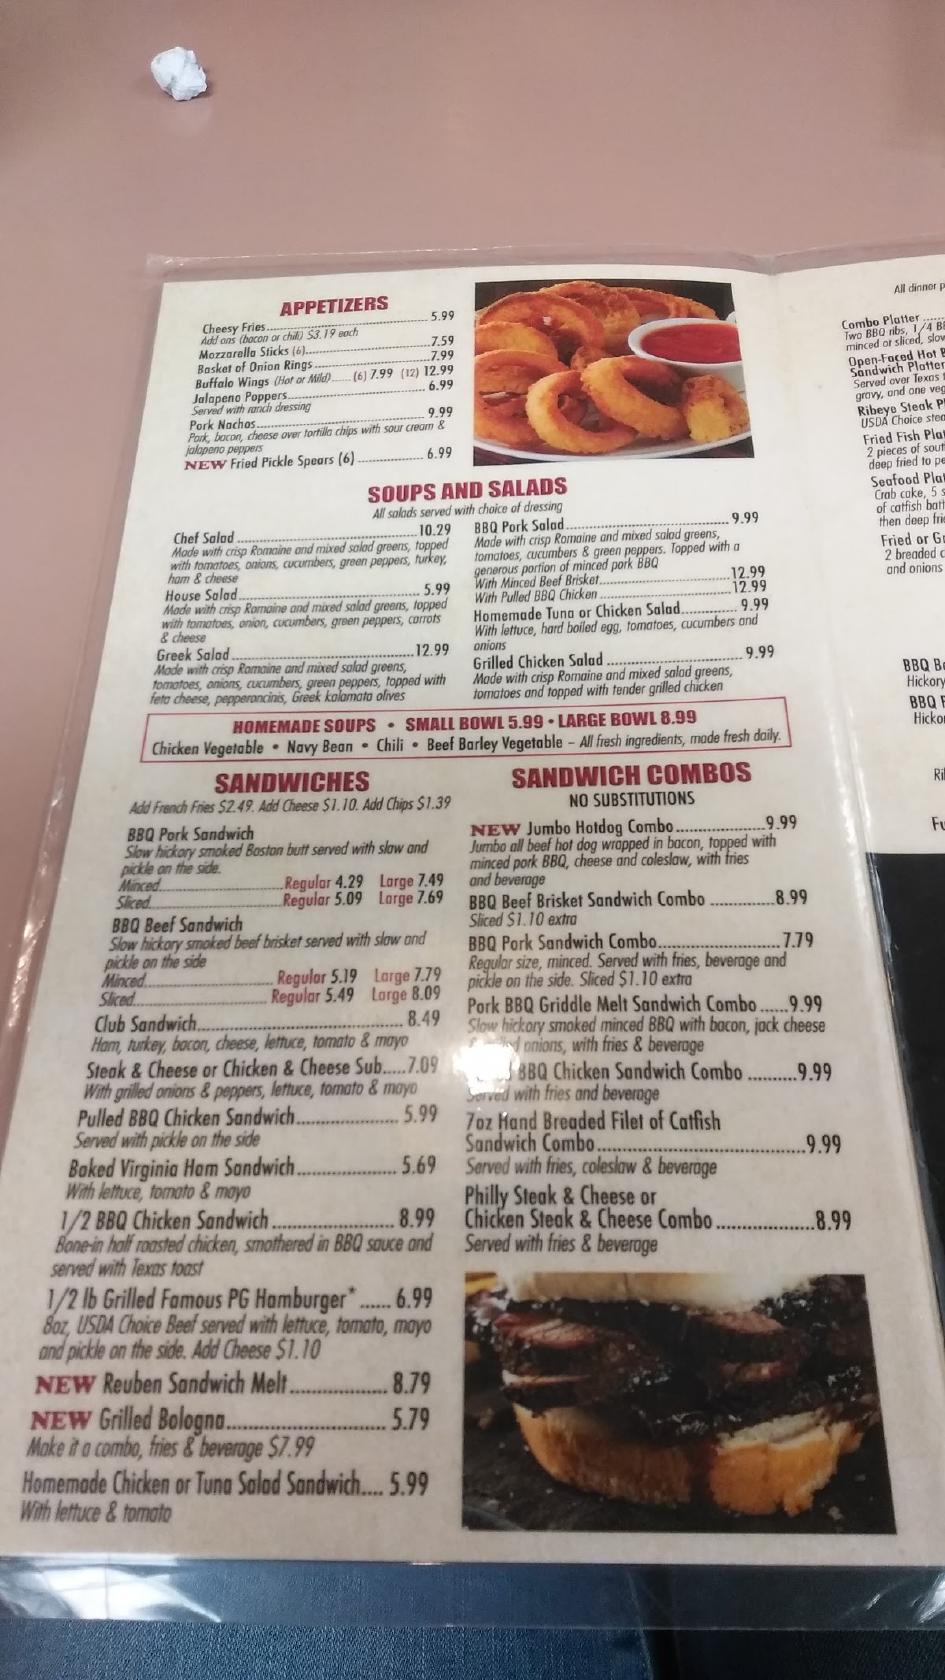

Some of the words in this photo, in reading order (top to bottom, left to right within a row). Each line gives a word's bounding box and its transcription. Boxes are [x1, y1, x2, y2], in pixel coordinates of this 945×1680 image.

[894, 284, 905, 294] All
[909, 283, 936, 292] dinner
[280, 296, 388, 316] APPETIZERS
[202, 323, 239, 334] Cheesy
[241, 322, 266, 332] Fries
[431, 311, 454, 321] 5.99
[842, 318, 879, 329] Combo
[883, 314, 919, 325] Platter
[201, 336, 218, 345] Add
[221, 336, 236, 344] ons
[240, 333, 268, 345] (bacon
[271, 332, 281, 341] or
[283, 330, 303, 341] chili)
[307, 329, 336, 339] $3.19
[339, 328, 359, 337] each
[199, 348, 256, 360] Mozzarella
[260, 347, 289, 357] Sticks
[292, 346, 305, 356] (6)
[431, 336, 454, 346] 7.59
[198, 363, 231, 374] Basket
[235, 362, 245, 372] of
[250, 361, 280, 371] Onion
[284, 360, 312, 371] Rings
[431, 351, 454, 361] 7.99
[849, 350, 913, 367] Open-Faced
[917, 350, 936, 358] Hot
[850, 362, 903, 377] Sandwich
[193, 392, 241, 404] Jalapeno
[245, 390, 287, 402] Poppers
[429, 380, 453, 391] 6.99
[857, 405, 897, 417] Ribeye
[900, 400, 933, 413] Steak
[864, 432, 892, 445] Fried
[897, 429, 920, 442] Fish
[184, 460, 227, 470] NEW
[230, 457, 257, 468] Fried
[261, 455, 293, 467] Pickle
[298, 454, 334, 467] Spears
[338, 451, 355, 466] (6)
[427, 447, 451, 459] 6.99
[368, 483, 436, 503] SOUPS
[441, 482, 483, 500] AND
[489, 477, 567, 498] SALADS
[871, 474, 919, 487] Seafood
[875, 489, 896, 500] Crab
[900, 487, 926, 499] cake,
[475, 522, 497, 534] BBQ
[502, 520, 528, 532] Pork
[532, 518, 564, 531] Salad
[731, 512, 759, 525] 9.99
[174, 533, 199, 545] Chef
[203, 531, 234, 544] Salad
[419, 524, 451, 536] 10.29
[475, 536, 501, 548] Made
[504, 535, 525, 546] with
[529, 534, 550, 546] crisp
[555, 532, 596, 545] Romaine
[600, 531, 617, 542] and
[622, 529, 651, 541] mixed
[655, 529, 680, 540] salad
[684, 529, 720, 541] greens,
[881, 532, 911, 546] Fried
[917, 535, 928, 544] or
[887, 562, 906, 574] and
[909, 564, 943, 573] onions
[165, 591, 201, 601] House
[205, 589, 237, 600] Salad
[424, 584, 450, 596] 5.99
[157, 650, 192, 661] Greek
[196, 649, 229, 661] Salad
[416, 644, 449, 656] 12.99
[473, 655, 513, 670] Grilled
[518, 654, 564, 668] Chicken
[569, 652, 603, 667] Salad
[746, 646, 774, 659] 9.99
[903, 659, 929, 671] BBQ
[233, 720, 320, 734] HOMEMADE
[324, 719, 375, 732] SOUPS
[406, 718, 455, 731] SMALL
[460, 717, 505, 730] BOWL
[508, 715, 544, 729] 5.99
[558, 713, 606, 727] LARGE
[611, 712, 657, 726] BOWL
[660, 710, 697, 724] 8.99
[214, 771, 370, 794] SANDWICHES
[512, 765, 641, 788] SANDWICH
[647, 762, 752, 784] COMBOS
[570, 794, 588, 808] NO
[593, 792, 695, 806] SUBSTITUTIONS
[127, 829, 154, 842] BBQ
[159, 829, 188, 841] Pork
[194, 828, 254, 840] Sandwich
[471, 824, 521, 837] NEW
[527, 822, 571, 835] Jumbo
[576, 821, 622, 836] Hotdog
[628, 819, 673, 834] Combo
[766, 815, 797, 830] 9.99
[469, 895, 498, 910] BBQ
[502, 894, 531, 909] Beef
[537, 893, 583, 909] Brisket
[588, 892, 653, 907] Sandwich
[658, 891, 705, 906] Combo
[776, 890, 807, 904] 8.99
[94, 1016, 125, 1032] Club
[131, 1015, 196, 1032] Sandwich
[408, 1011, 440, 1026] 8.49
[466, 1113, 492, 1130] 7oz
[499, 1111, 537, 1130] Hand
[544, 1110, 605, 1130] Breaded
[611, 1110, 644, 1129] Filet
[649, 1110, 664, 1129] of
[669, 1110, 720, 1130] Catfish
[466, 1133, 536, 1152] Sandwich
[543, 1134, 594, 1151] Combo
[807, 1134, 841, 1153] 9.99
[68, 1160, 115, 1177] Baked
[120, 1159, 178, 1181] Virginia
[183, 1159, 219, 1176] Ham
[225, 1157, 295, 1175] Sandwich
[402, 1156, 436, 1174] 5.69
[465, 1186, 508, 1208] Philly
[514, 1186, 557, 1204] Steak
[563, 1187, 575, 1204] &
[581, 1186, 635, 1204] Cheese
[641, 1190, 656, 1203] or
[465, 1209, 524, 1228] Chicken
[531, 1209, 574, 1228] Steak
[580, 1210, 592, 1227] &
[598, 1210, 652, 1227] Cheese
[658, 1208, 712, 1228] Combo
[815, 1210, 851, 1230] 8.99
[47, 1289, 77, 1313] 1/2
[83, 1290, 96, 1308] lb
[103, 1288, 155, 1309] Grilled
[161, 1289, 222, 1308] Famous
[228, 1289, 250, 1308] PG
[396, 1288, 432, 1308] 6.99
[35, 1376, 96, 1394] NEW
[103, 1374, 162, 1393] Reuben
[168, 1370, 244, 1393] Sandwich
[251, 1372, 287, 1393] Melt
[393, 1372, 431, 1393] 8.79
[31, 1411, 92, 1430] NEW
[100, 1407, 151, 1430] Grilled
[158, 1407, 224, 1435] Bologna
[392, 1407, 430, 1430] 5.79
[22, 1473, 106, 1494] Homemade
[113, 1471, 170, 1494] Chicken
[176, 1476, 190, 1493] or
[196, 1471, 232, 1494] Tuna
[239, 1471, 281, 1494] Salad
[287, 1471, 361, 1495] Sandwich
[390, 1473, 428, 1495] 5.99
